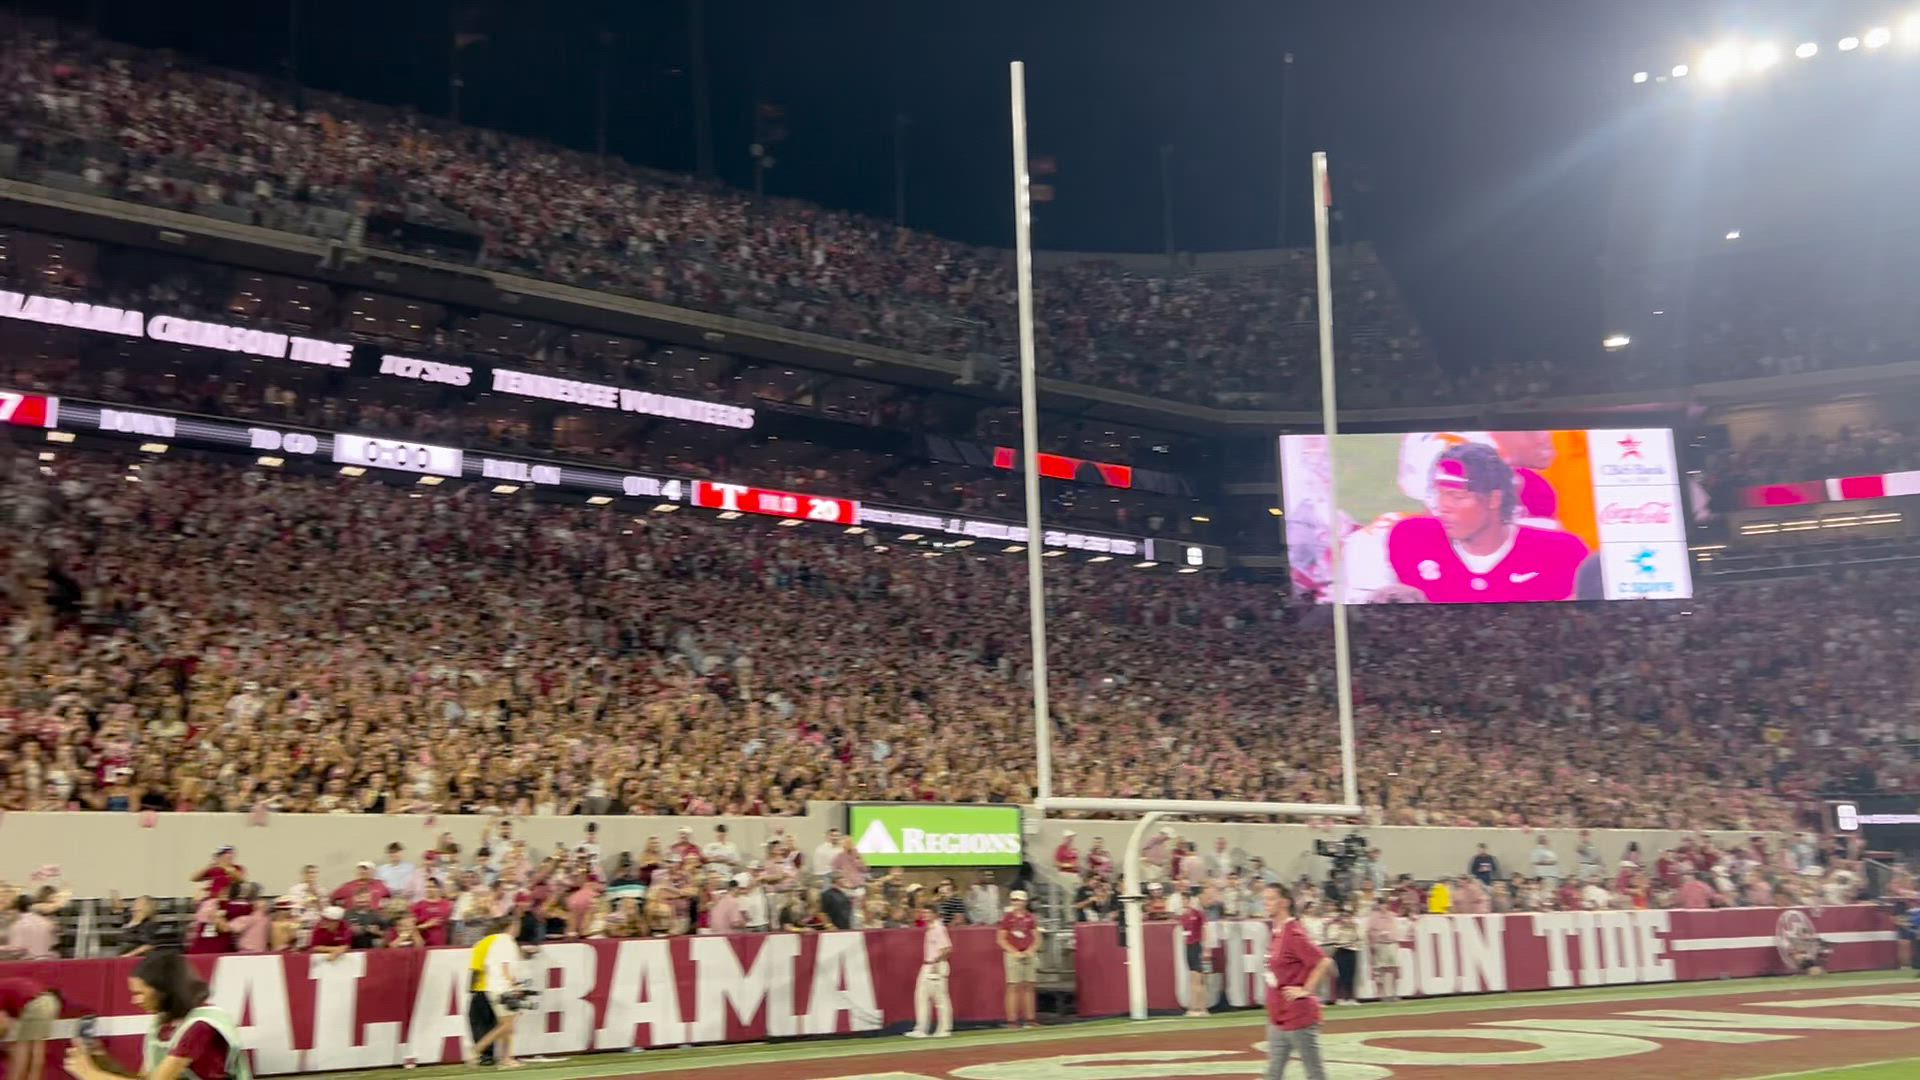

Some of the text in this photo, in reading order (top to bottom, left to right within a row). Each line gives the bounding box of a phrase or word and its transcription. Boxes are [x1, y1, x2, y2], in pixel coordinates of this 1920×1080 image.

[290, 336, 353, 367] TIDE
[492, 369, 755, 429] TENNESSEE VOLUNTEERS
[660, 479, 682, 500] 4
[806, 499, 840, 521] 20
[203, 931, 884, 1076] ALABAMA
[1531, 911, 1677, 988] TIDE
